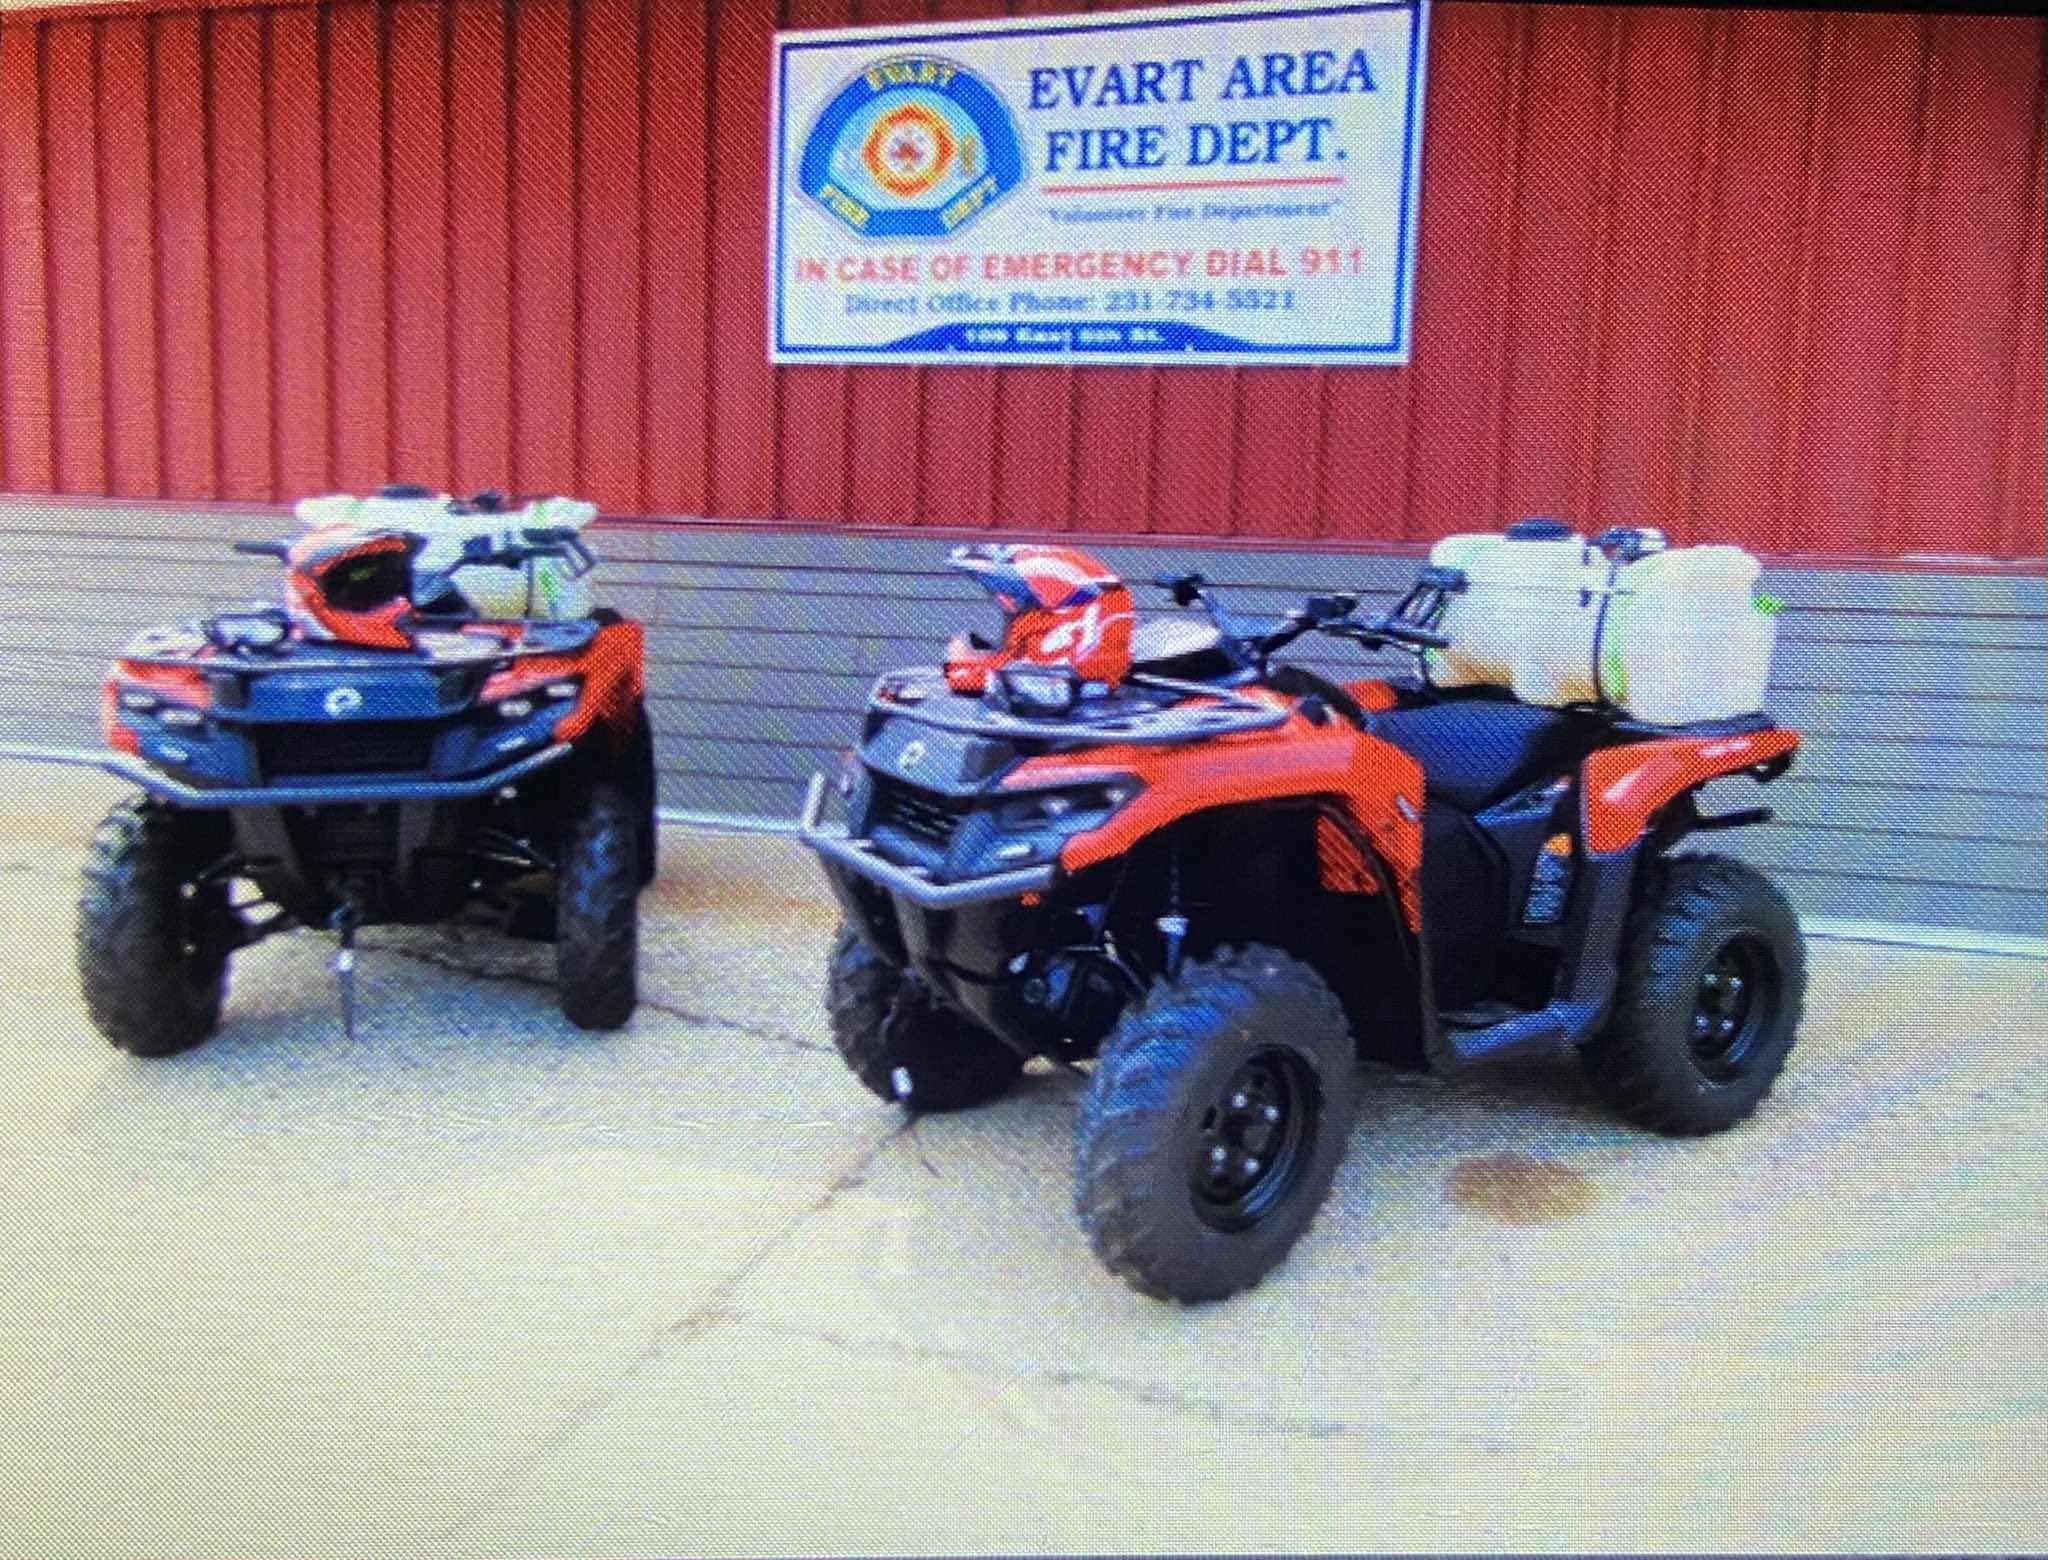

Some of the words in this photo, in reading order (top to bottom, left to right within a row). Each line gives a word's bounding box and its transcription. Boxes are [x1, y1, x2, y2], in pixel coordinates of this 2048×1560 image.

[1029, 59, 1204, 110] EVART
[1221, 48, 1378, 100] AREA
[1045, 125, 1168, 172] FIRE
[1186, 117, 1348, 167] DEPT.
[795, 255, 828, 281] IN
[836, 254, 918, 282] CASE
[929, 253, 970, 281] OF
[983, 250, 1193, 280] EMERGENCY
[1205, 247, 1289, 277] DIAL
[1301, 246, 1365, 276] 911
[845, 293, 918, 314] Direct
[926, 291, 1000, 313] Office
